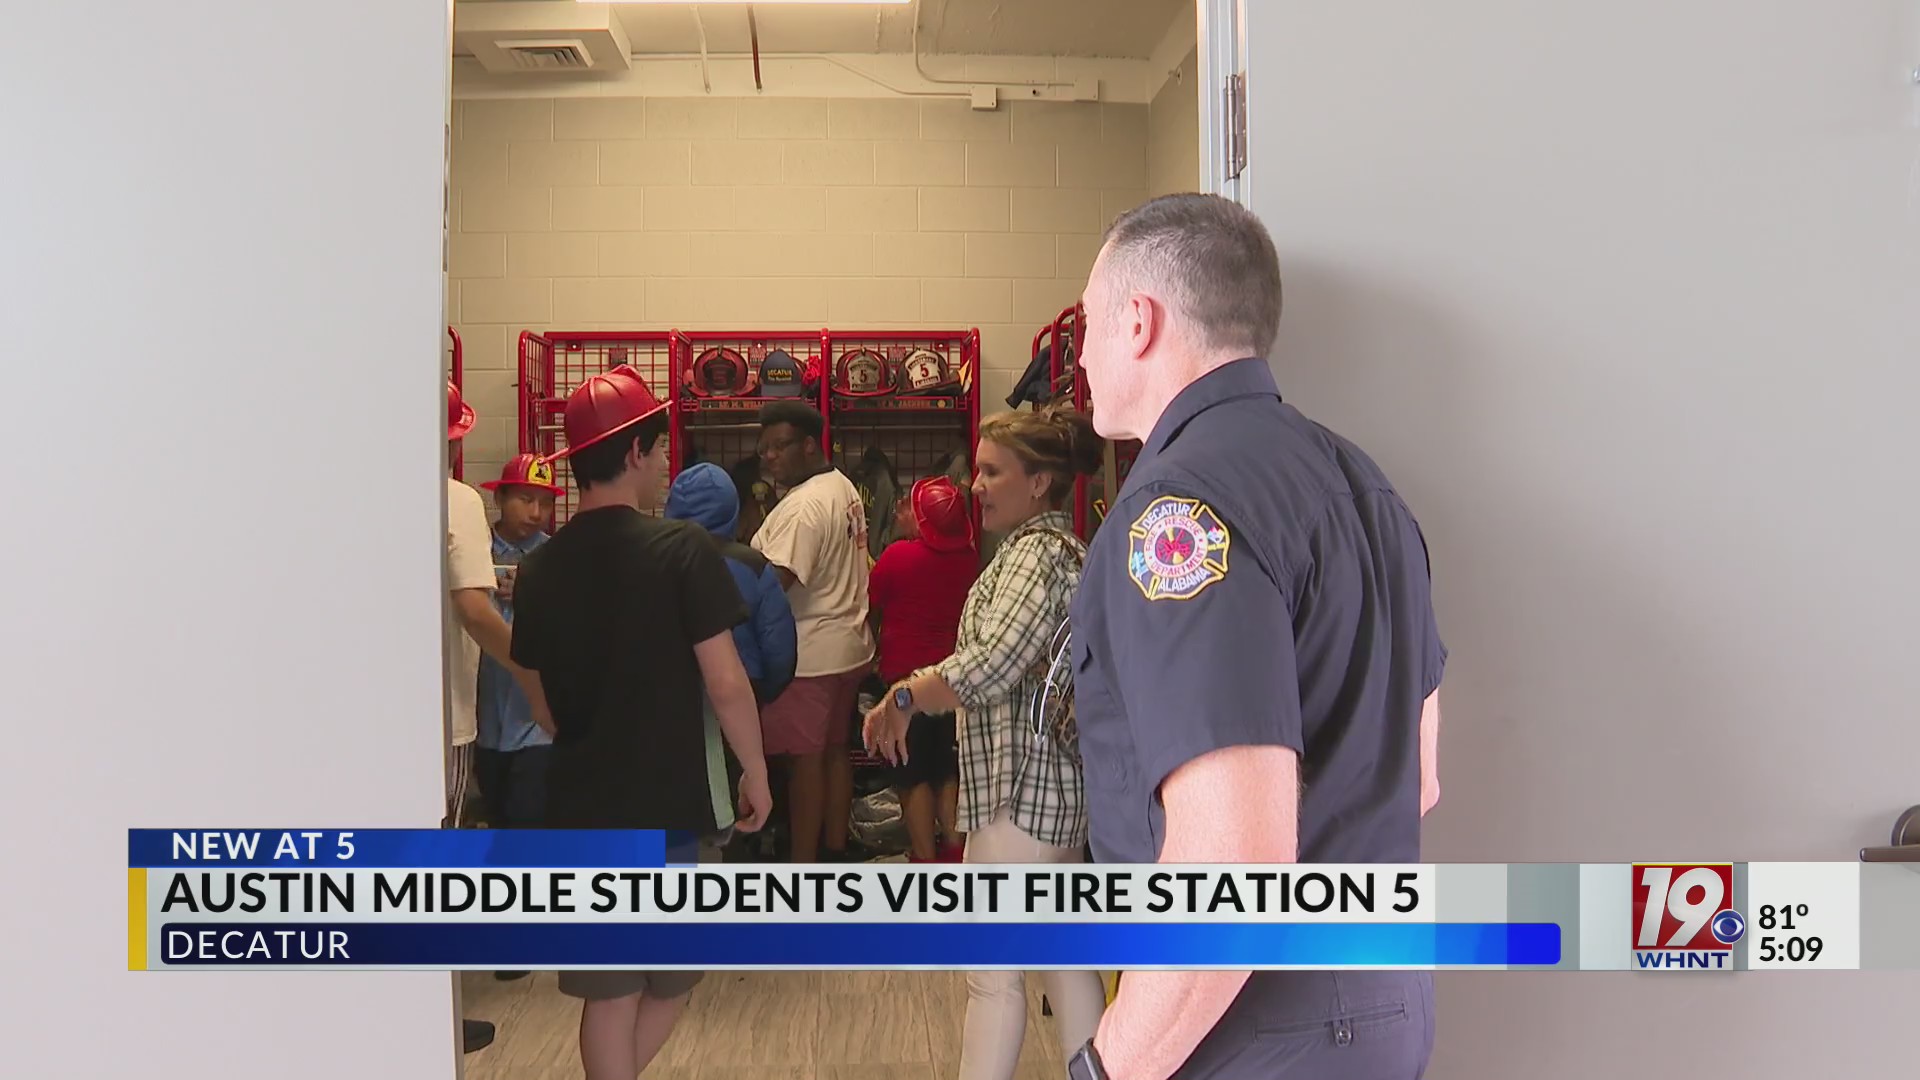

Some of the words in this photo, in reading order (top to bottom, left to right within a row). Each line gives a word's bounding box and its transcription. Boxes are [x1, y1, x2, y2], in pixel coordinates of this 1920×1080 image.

[859, 369, 868, 383] 5
[919, 363, 929, 378] 5
[1141, 502, 1192, 531] DECATUR
[1164, 517, 1202, 537] RESCUE
[1150, 546, 1206, 576] DEPARTMENT
[1158, 566, 1211, 593] ALABAMA
